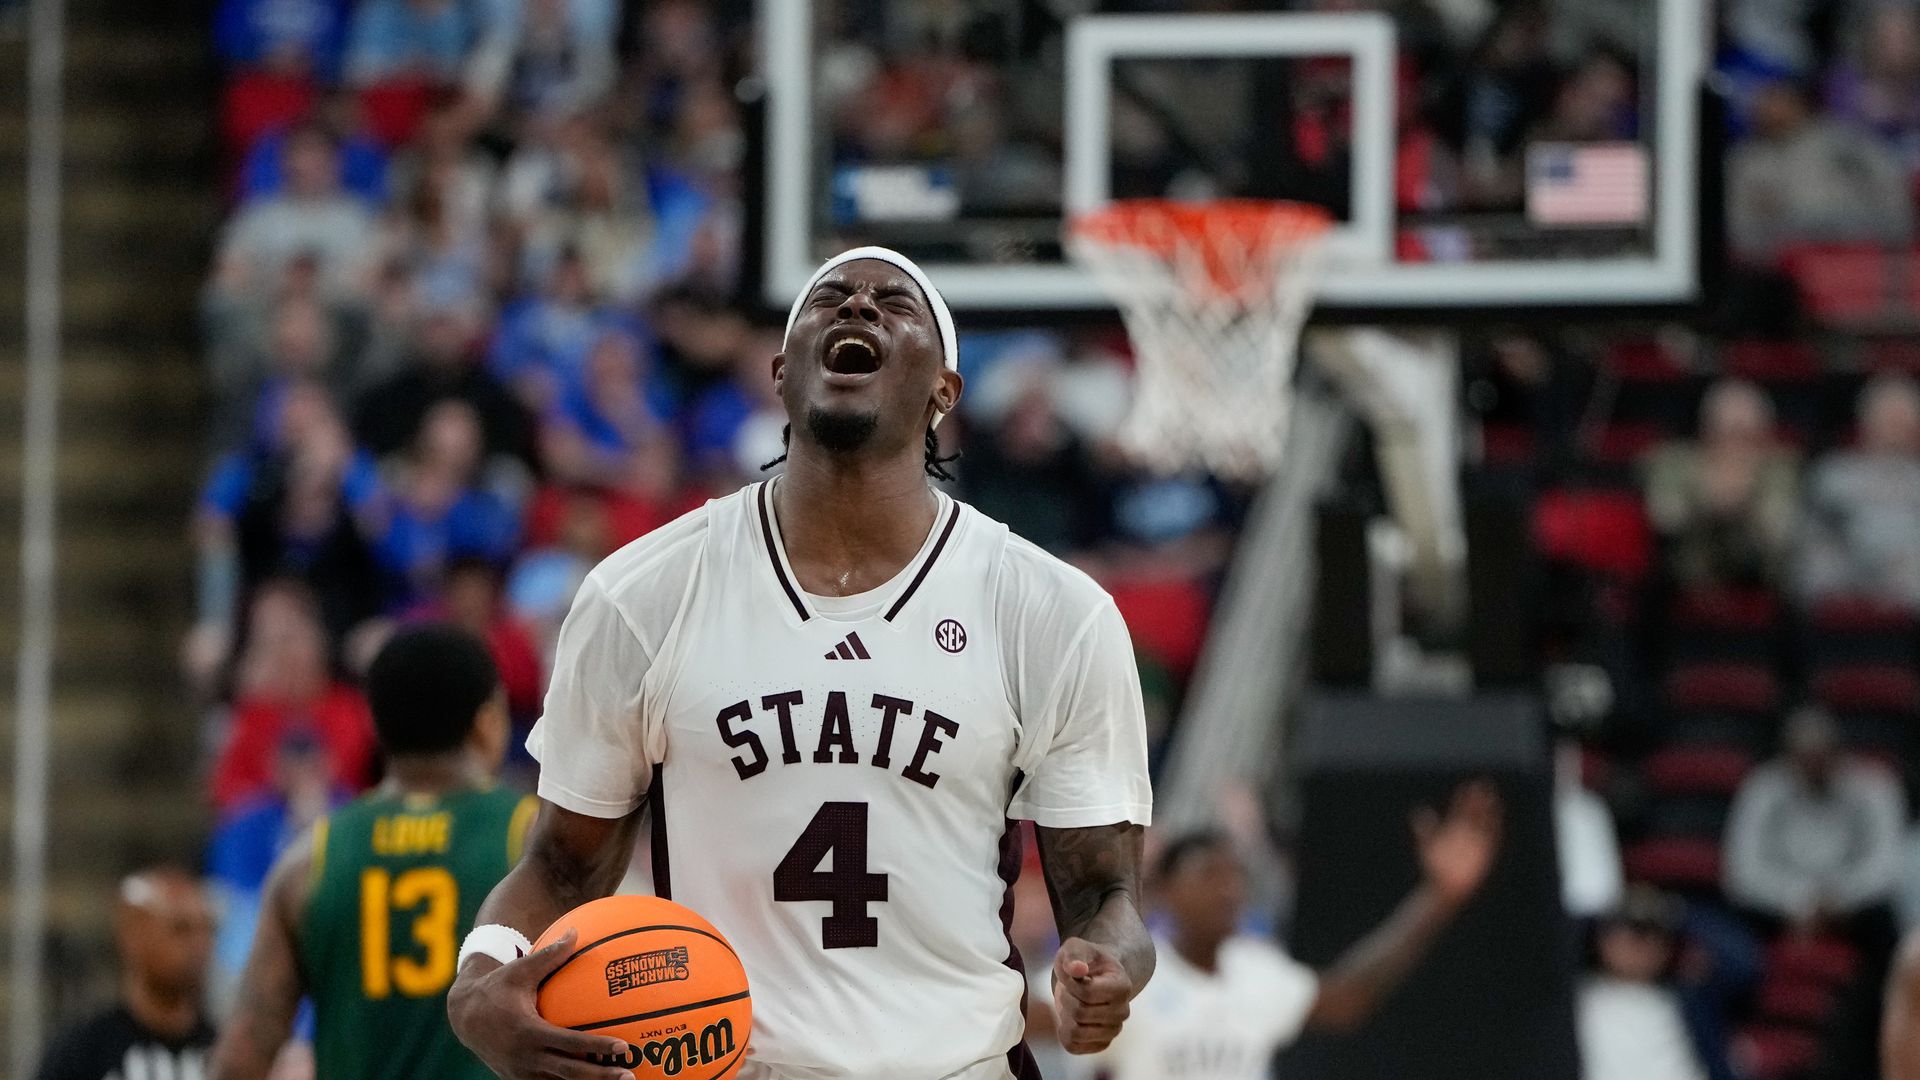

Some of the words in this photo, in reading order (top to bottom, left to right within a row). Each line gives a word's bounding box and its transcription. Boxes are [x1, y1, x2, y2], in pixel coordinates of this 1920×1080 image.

[937, 620, 966, 652] SEC
[716, 690, 960, 789] STATE
[373, 815, 449, 855] LOVE
[773, 802, 888, 949] 4
[361, 866, 458, 999] 13
[607, 957, 666, 979] MADNESS
[632, 967, 676, 986] MARCH
[640, 1030, 662, 1039] NXT
[666, 1024, 687, 1034] EVO
